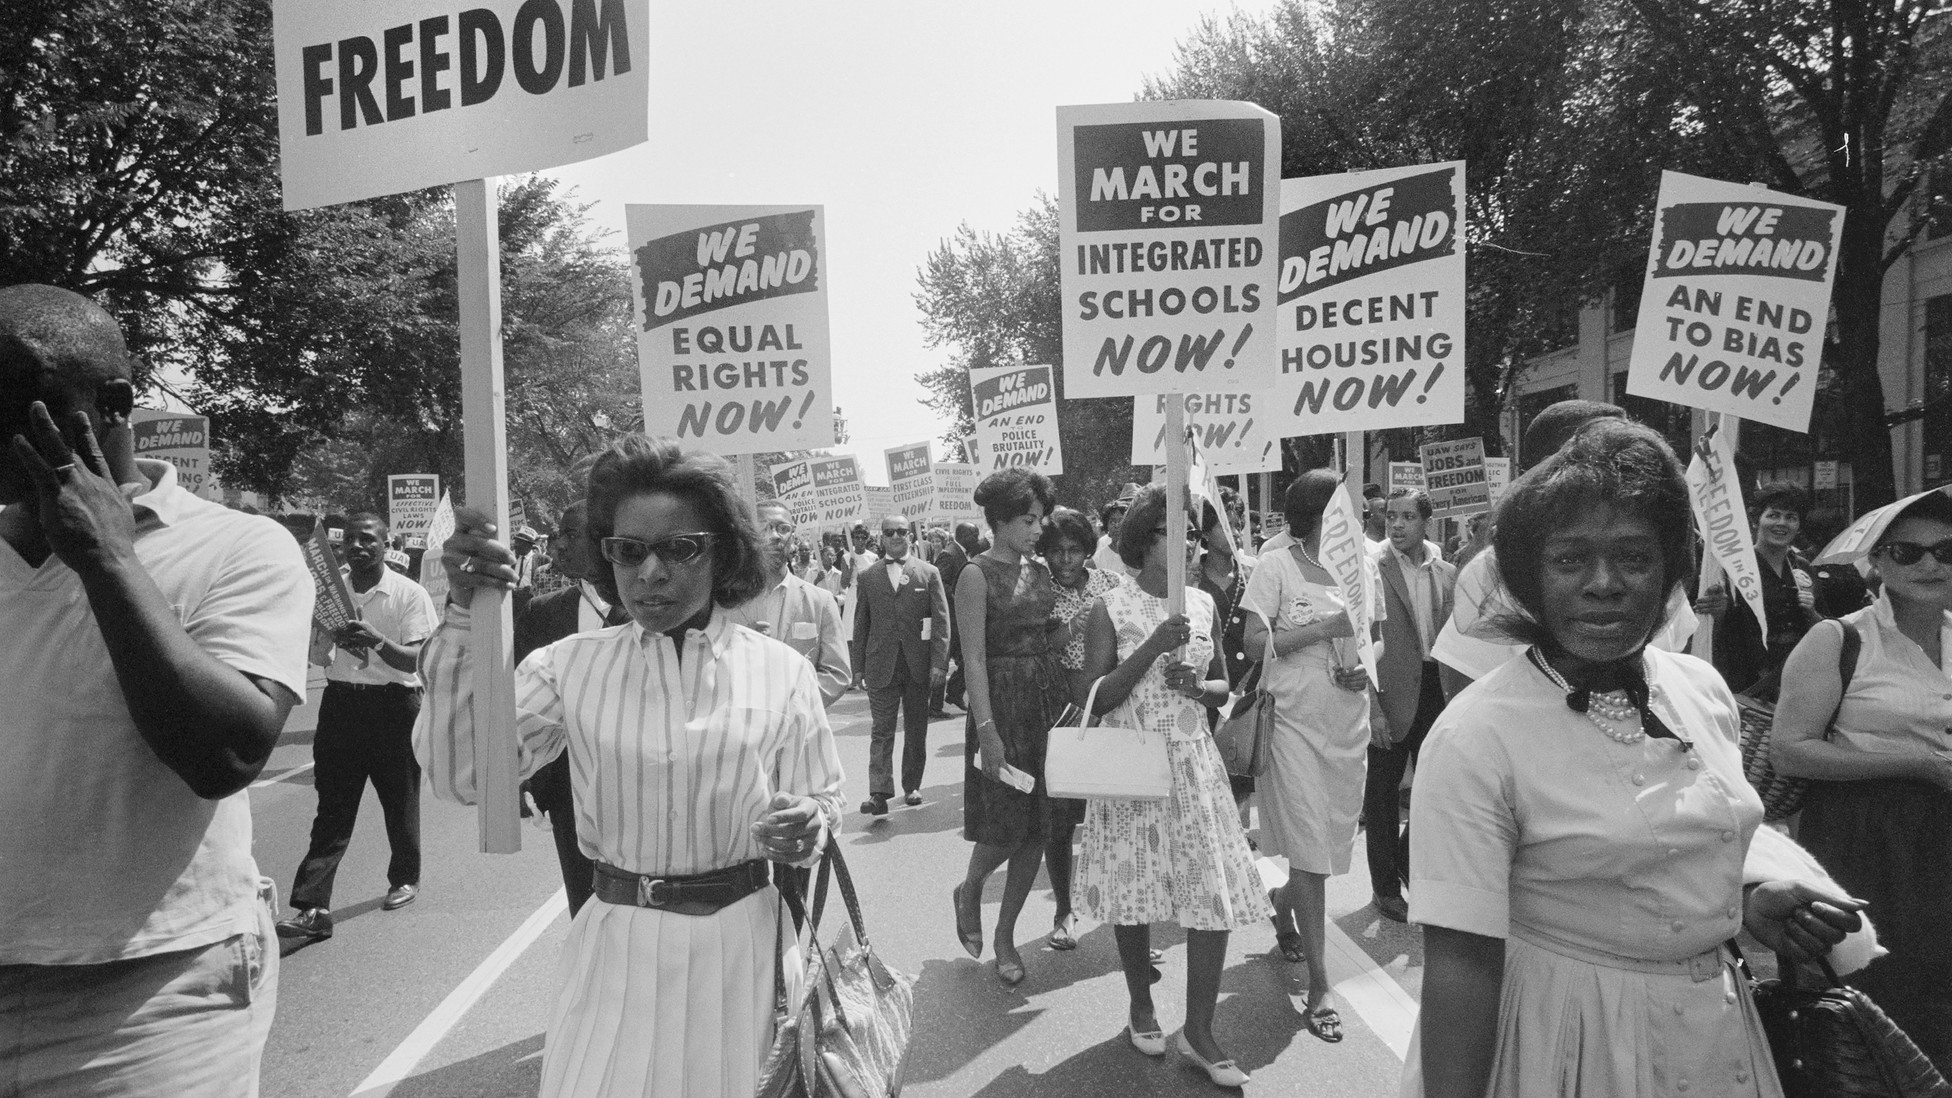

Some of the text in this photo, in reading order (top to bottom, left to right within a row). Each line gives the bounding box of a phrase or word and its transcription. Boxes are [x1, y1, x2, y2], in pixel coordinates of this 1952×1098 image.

[302, 0, 631, 136] FREEDOM
[1142, 129, 1197, 158] WE
[1090, 161, 1249, 201] MARCH
[1141, 204, 1202, 222] FOR
[1325, 187, 1394, 239] WE
[1716, 205, 1783, 236] WE
[696, 223, 760, 267] WE
[1278, 210, 1450, 294] DEMAND
[1666, 237, 1825, 270] DEMAND
[1077, 237, 1263, 275] INTEGRATED
[654, 249, 812, 317] DEMAND
[1078, 283, 1261, 321] SCHOOLS
[1296, 291, 1439, 331] DECENT
[1665, 284, 1812, 335] AN END
[672, 324, 802, 354] EQUAL
[1093, 322, 1253, 377] NOW!
[1665, 316, 1805, 368] TO BIAS
[1281, 332, 1453, 374] HOUSING
[672, 359, 809, 391] RIGHTS
[999, 372, 1026, 393] WE
[1659, 351, 1801, 405] NOW!
[981, 383, 1048, 416] DEMAND
[1293, 361, 1445, 417] NOW!
[676, 389, 815, 439] NOW!
[988, 414, 1045, 428] AN END
[156, 420, 183, 433] WE
[1002, 429, 1037, 441] POLICE
[139, 431, 202, 450] DEMAND
[992, 440, 1044, 453] BRUTALITY
[1427, 442, 1477, 456] UAW SAYS
[826, 461, 840, 470] WE
[893, 456, 927, 473] MARCH
[902, 450, 914, 460] WE
[993, 446, 1054, 470] NOW!
[1426, 455, 1481, 472] JOBS and
[788, 463, 806, 479] WE
[816, 467, 854, 481] MARCH
[952, 468, 973, 476] RIGHTS
[1427, 469, 1485, 489] FREEDOM
[395, 486, 432, 495] MARCH
[780, 473, 811, 494] DEMA
[816, 483, 860, 498] INTEGRATED
[893, 481, 912, 493] FIRST
[913, 476, 933, 488] CLASS
[893, 485, 935, 503] CITIZENSHIP
[785, 490, 813, 501] AN EN
[818, 493, 862, 508] SCHOOLS
[939, 501, 972, 510] REEDOM
[1452, 494, 1488, 506] American
[1708, 449, 1743, 558] FREEDOM
[825, 503, 862, 521] NOW!
[901, 498, 933, 516] NOW!
[396, 519, 433, 529] NOW!
[307, 537, 331, 578] MARCH
[1321, 506, 1362, 611] FREEDOM
[323, 598, 346, 629] FREEDO
